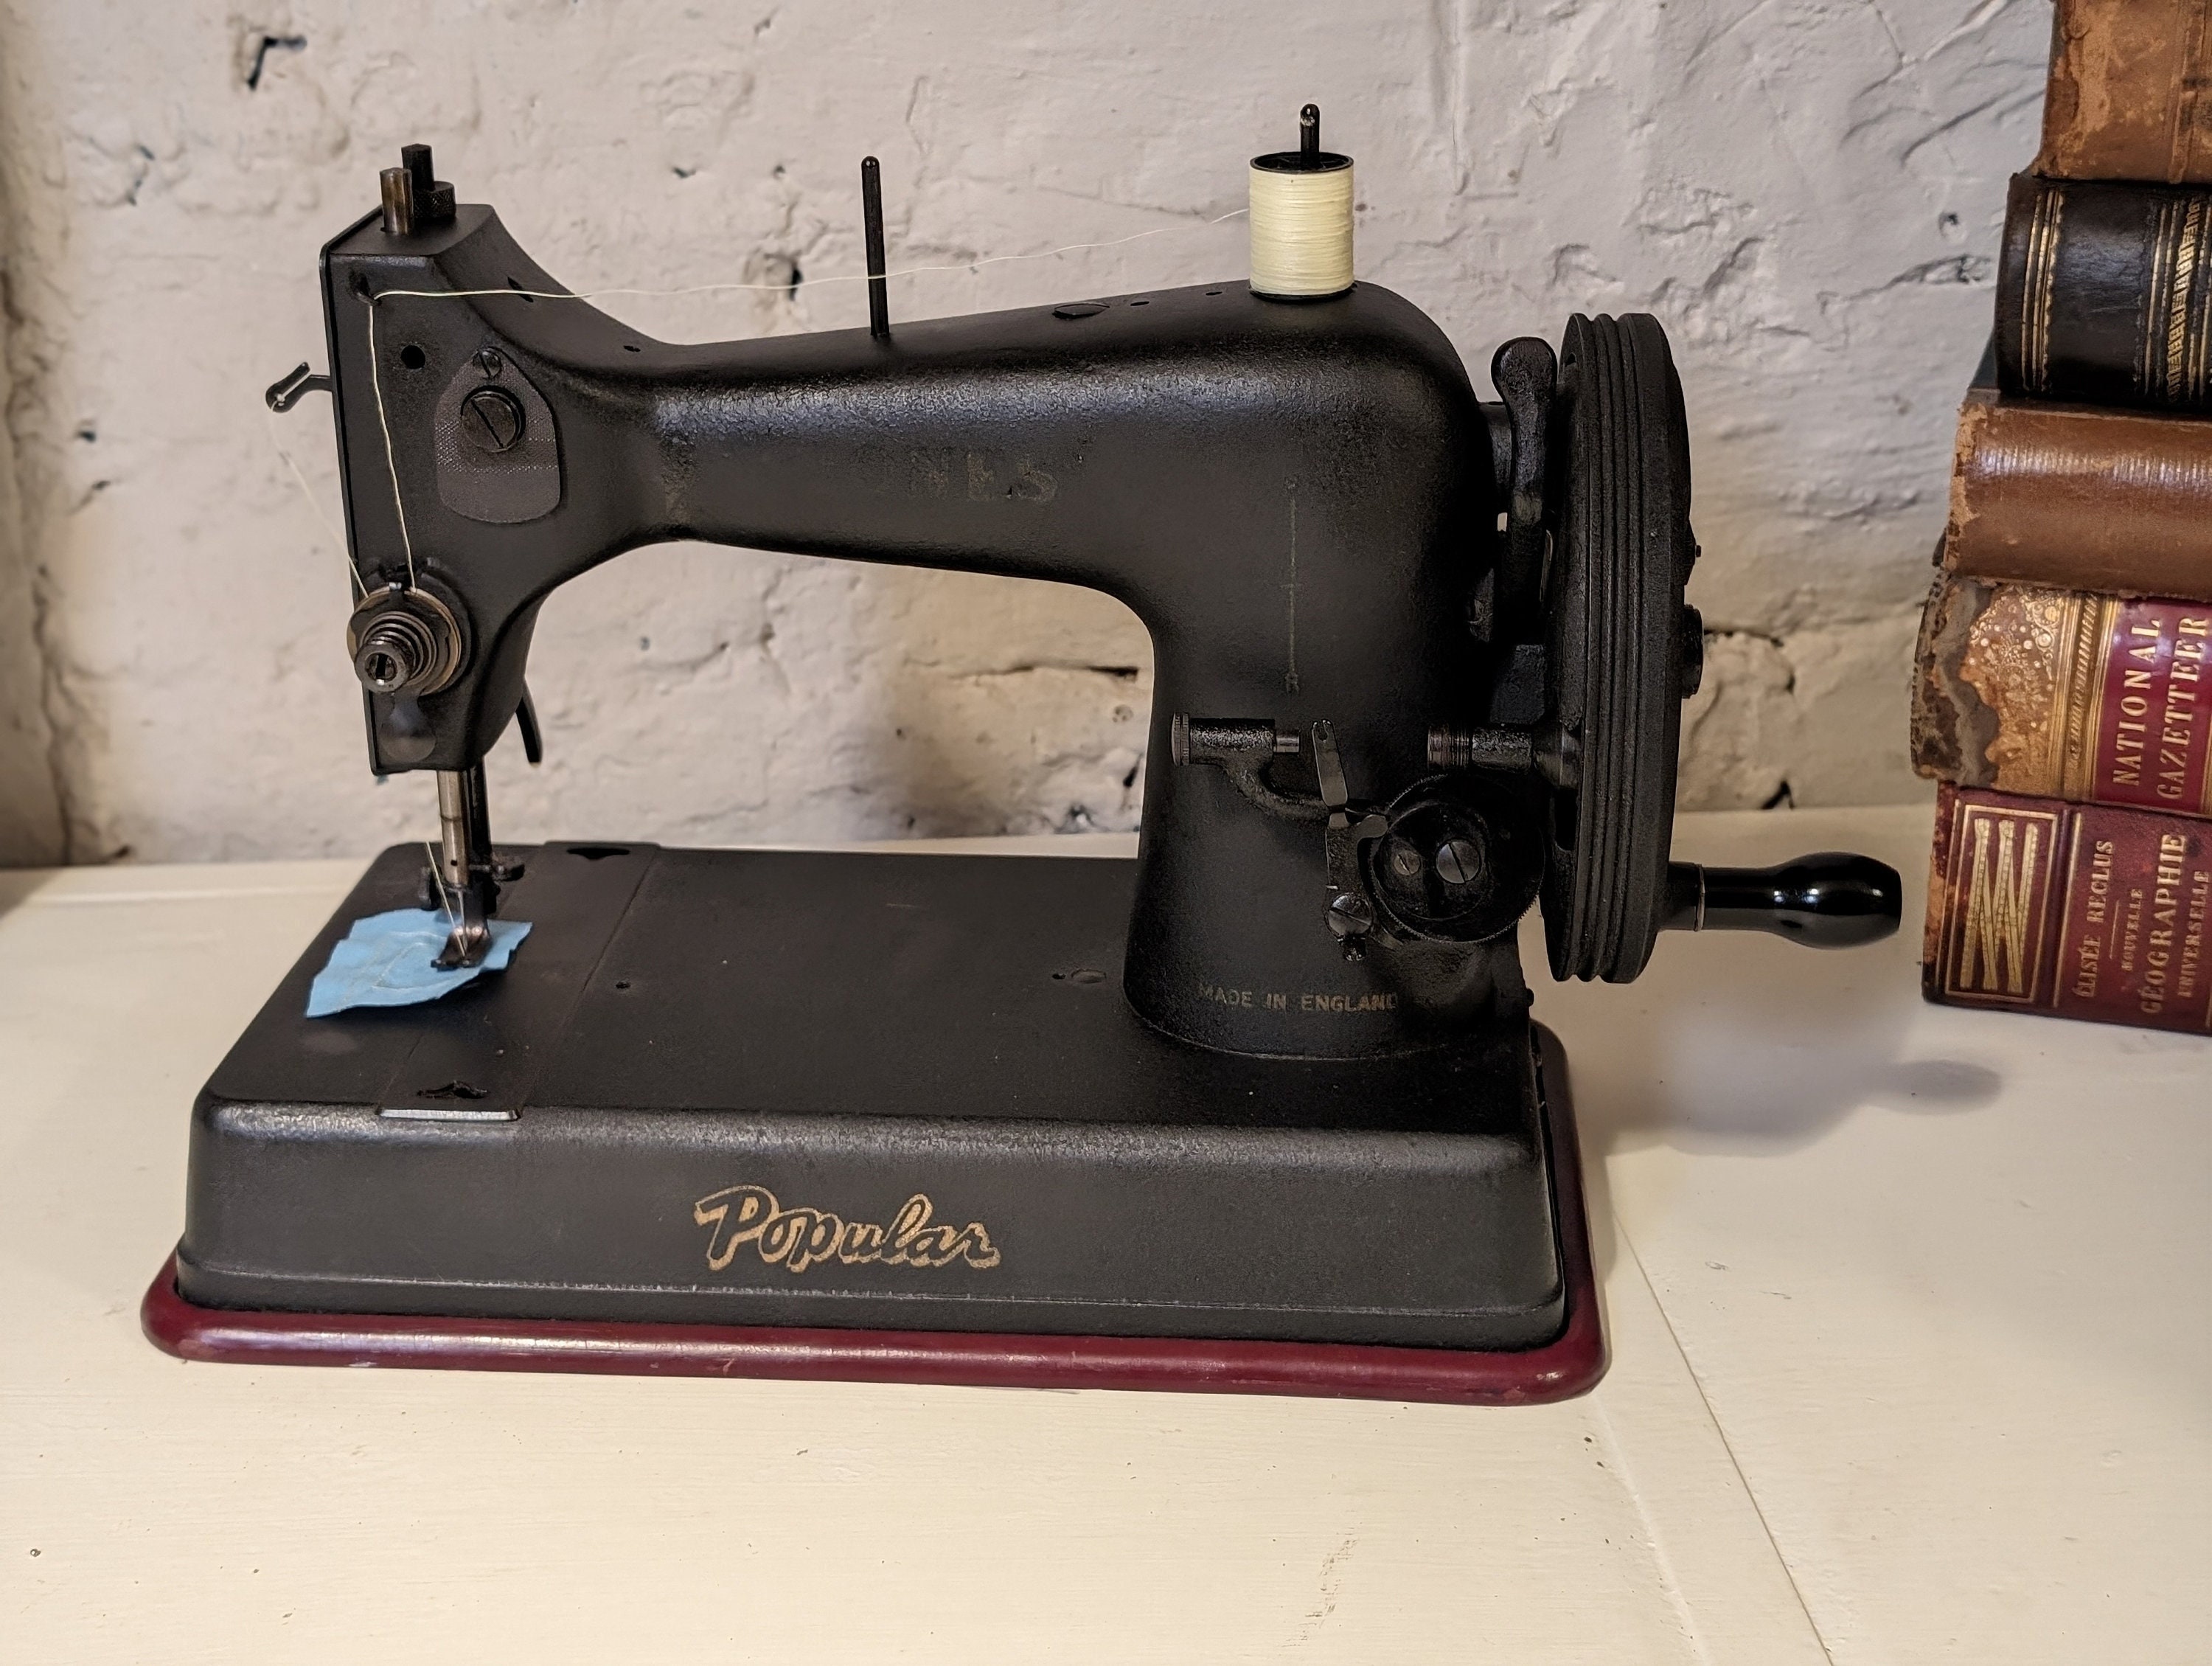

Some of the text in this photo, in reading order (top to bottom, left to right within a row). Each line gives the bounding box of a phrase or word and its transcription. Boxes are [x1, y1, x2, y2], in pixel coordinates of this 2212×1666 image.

[2112, 619, 2160, 786] NATIONAL
[2157, 617, 2209, 800] GAZETTEER
[2087, 840, 2114, 923] RECLUS
[2139, 834, 2186, 1013] GÉOGRAPHIE
[2177, 870, 2210, 997] UNIVERSELLE
[1198, 983, 1397, 1013] MADE IN ENGLAND
[694, 1184, 1002, 1274] Popular
